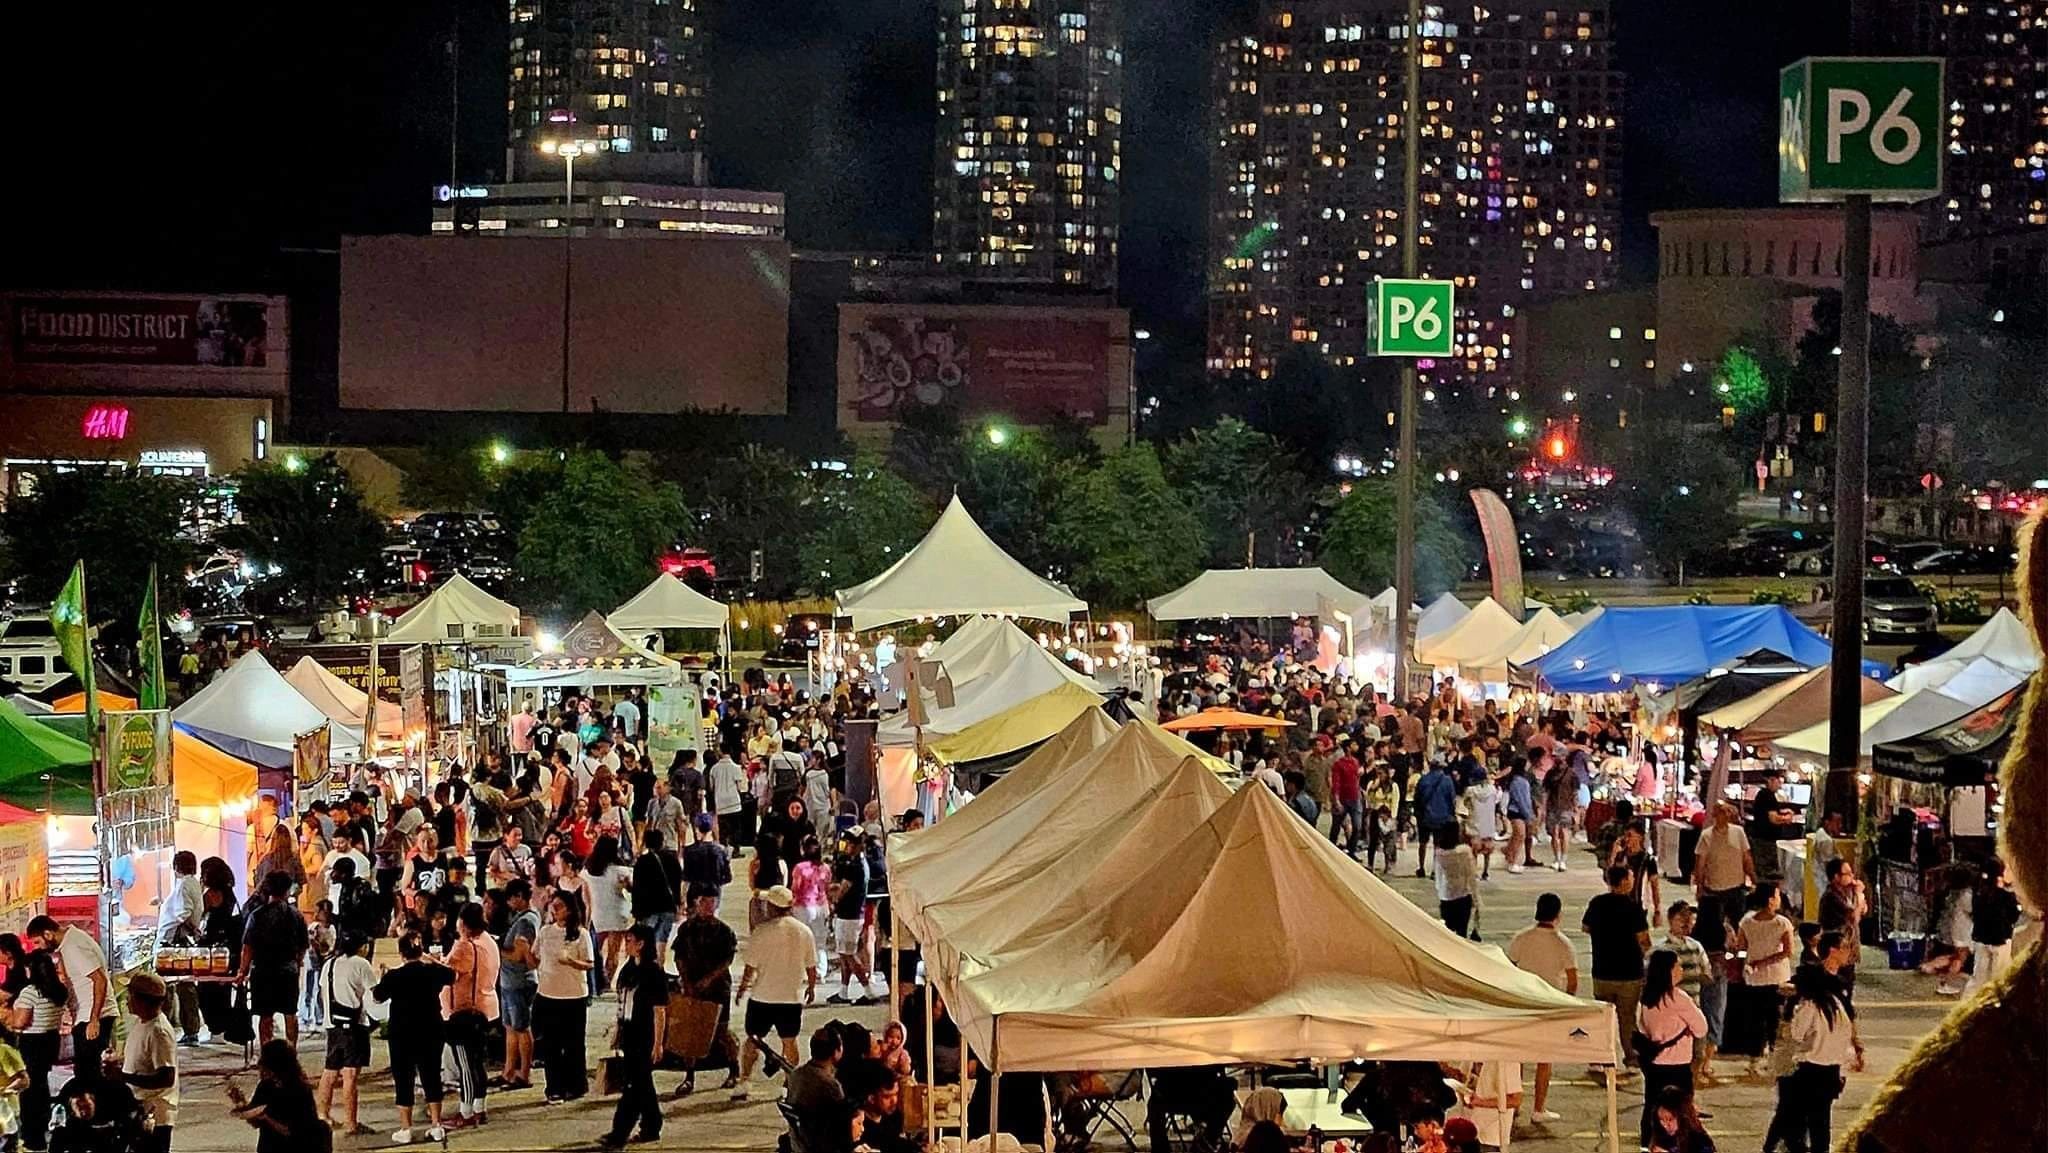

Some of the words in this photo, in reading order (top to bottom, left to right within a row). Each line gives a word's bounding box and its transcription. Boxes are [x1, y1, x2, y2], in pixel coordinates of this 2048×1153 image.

[1827, 87, 1921, 165] P6
[98, 312, 189, 339] DISTRICT
[1390, 296, 1442, 340] P6
[85, 409, 128, 439] H&M
